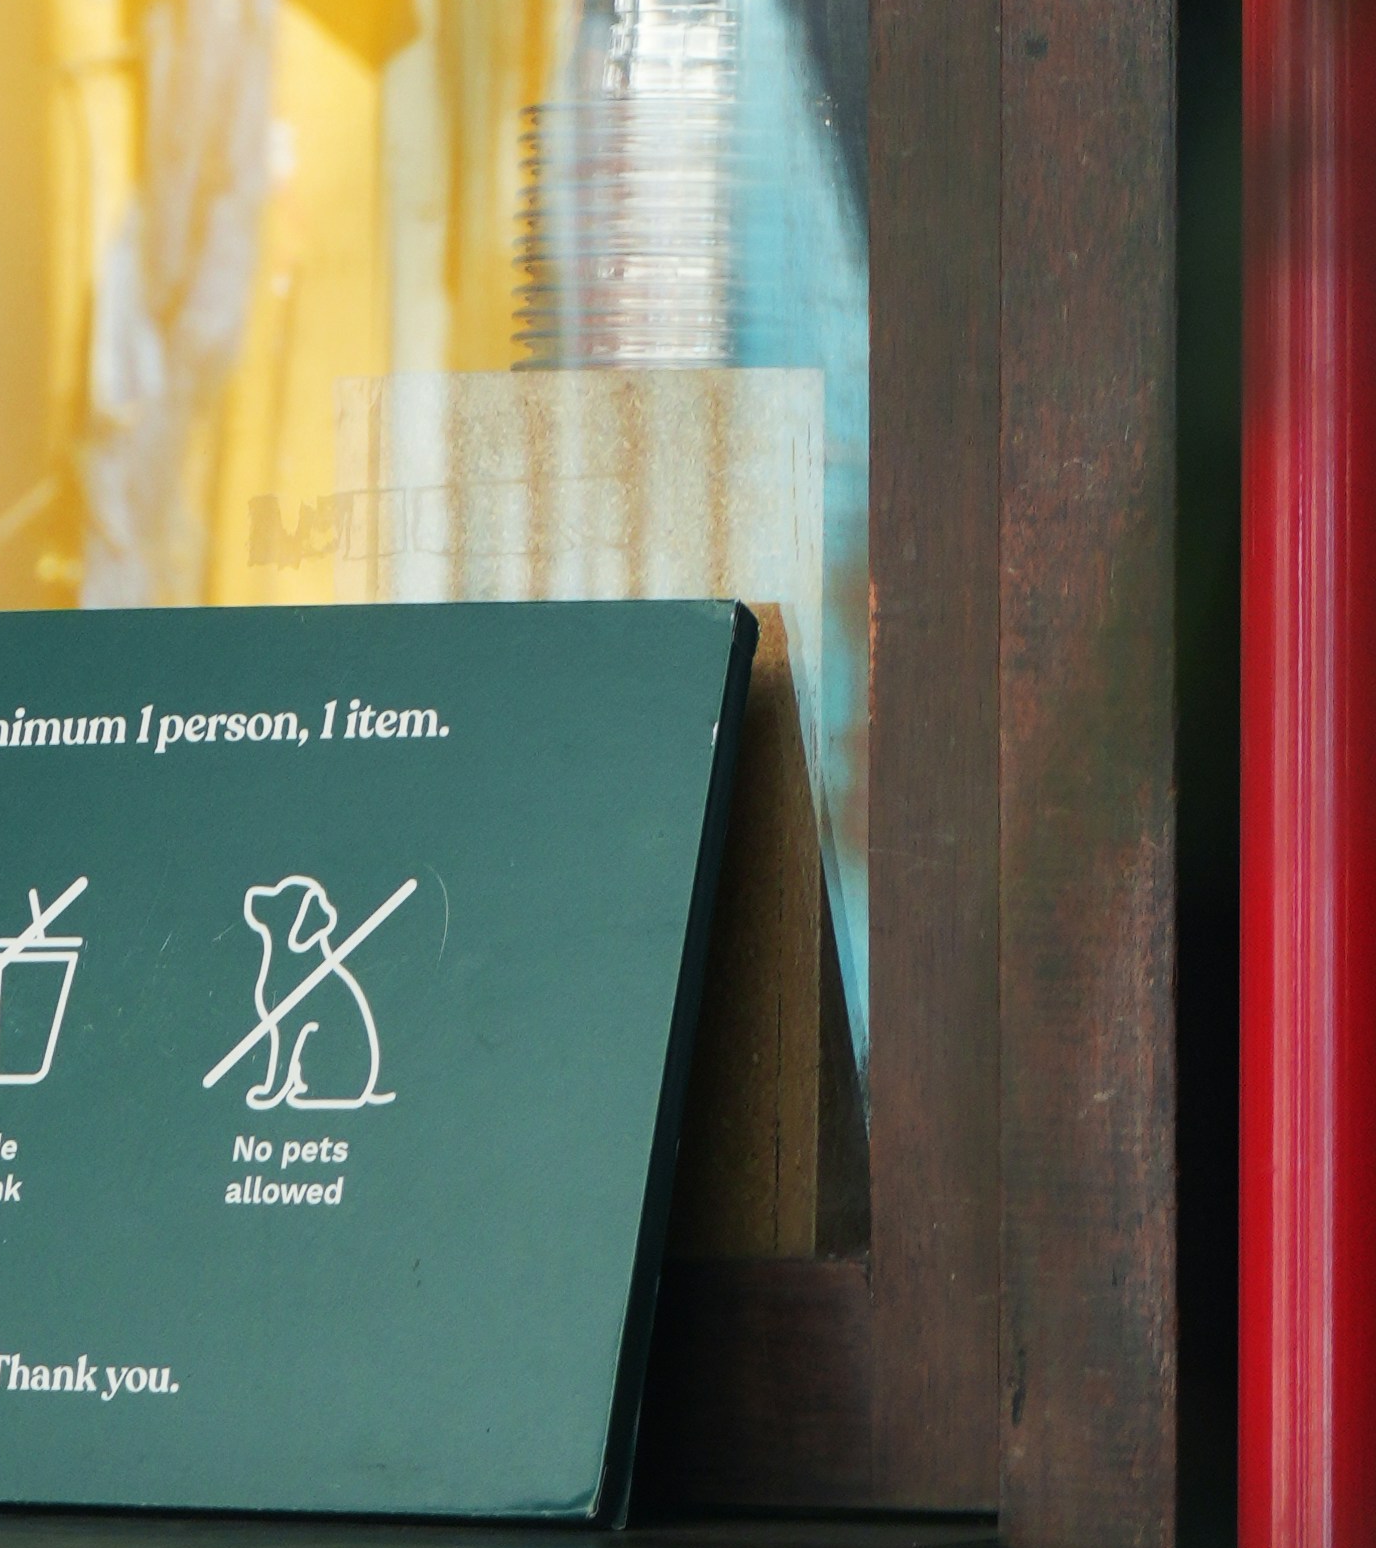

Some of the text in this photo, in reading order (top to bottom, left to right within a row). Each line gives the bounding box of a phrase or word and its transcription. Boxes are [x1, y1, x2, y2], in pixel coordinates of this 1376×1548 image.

[154, 707, 309, 754] person,
[319, 700, 338, 740] 1
[344, 699, 451, 739] item.
[232, 1136, 349, 1169] No pets
[225, 1176, 344, 1204] allowed
[100, 1366, 180, 1401] you.
